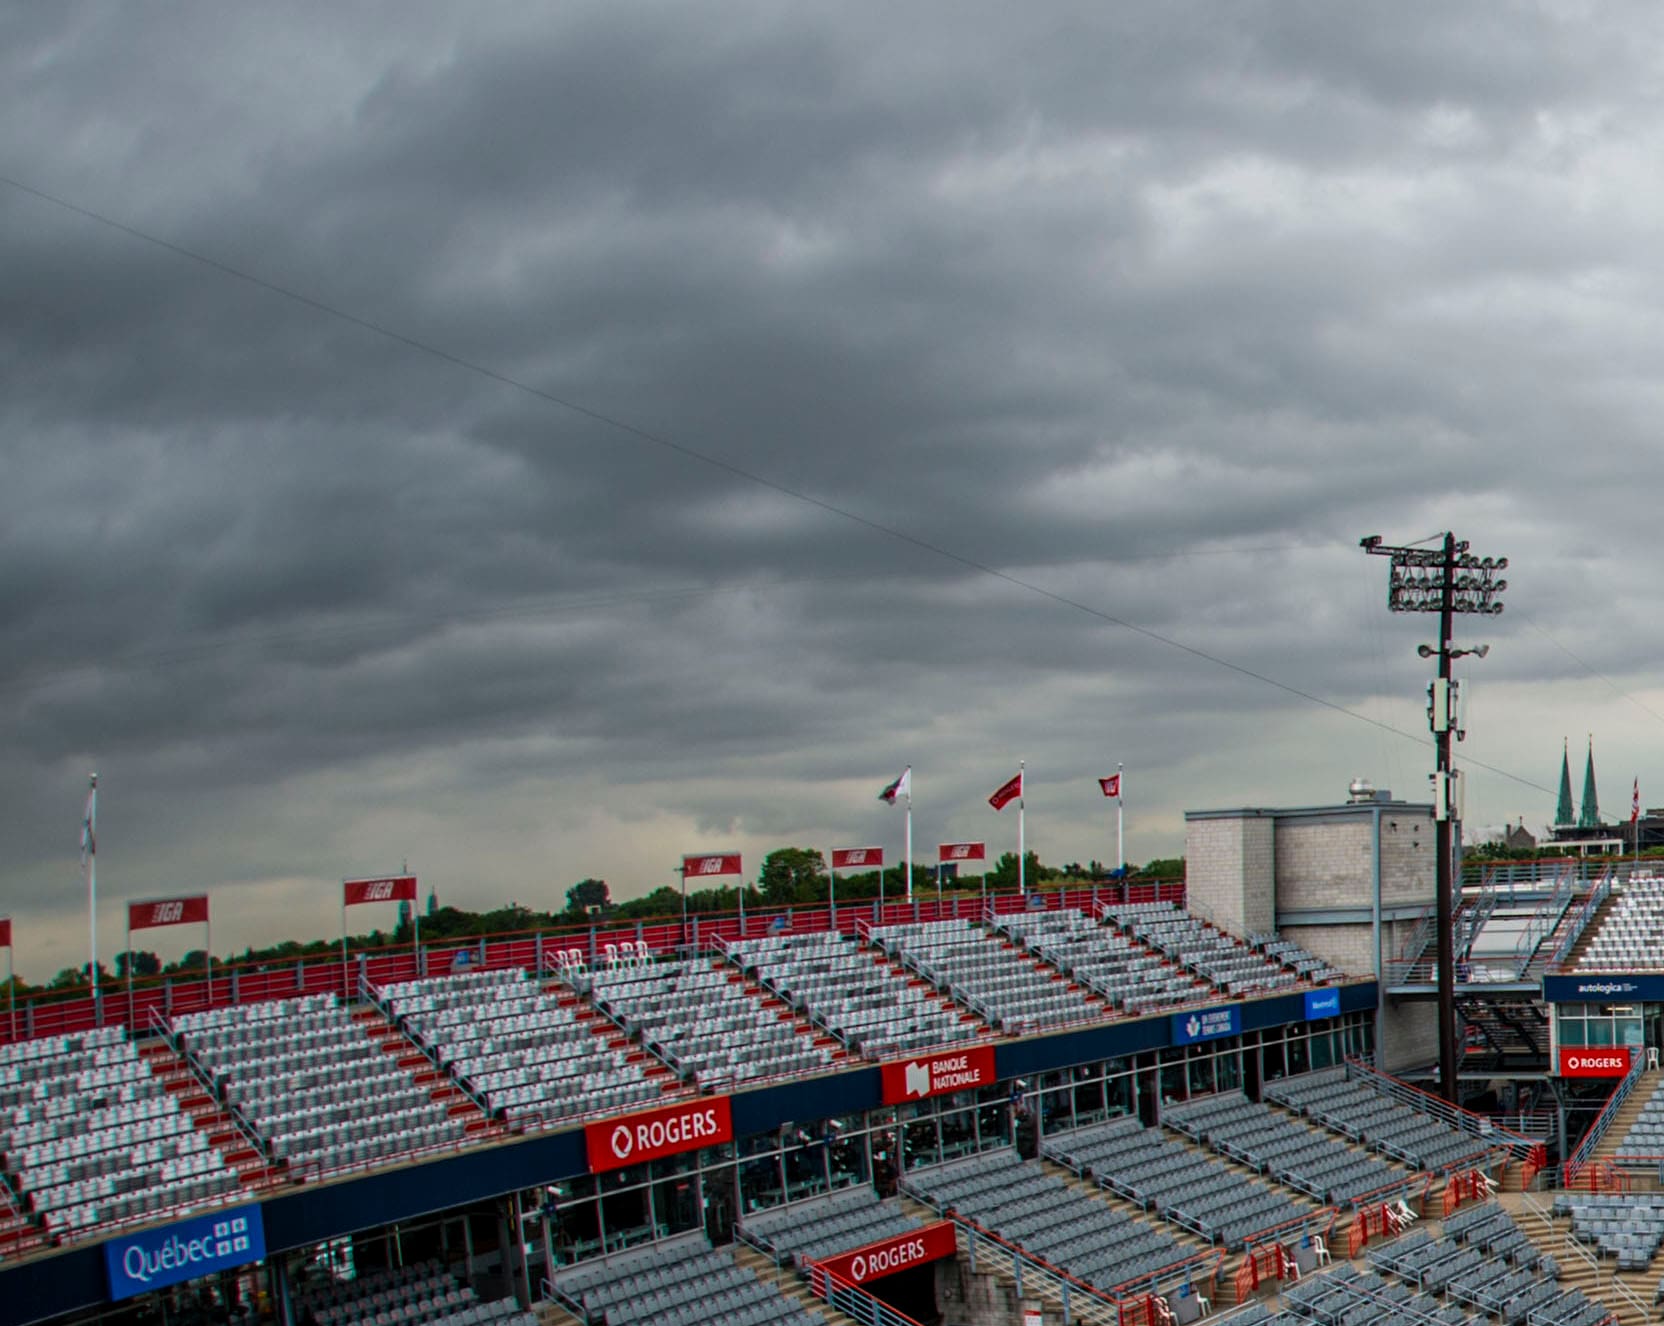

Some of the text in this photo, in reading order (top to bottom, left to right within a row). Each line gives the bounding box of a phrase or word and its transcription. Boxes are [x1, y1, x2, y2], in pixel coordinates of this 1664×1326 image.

[1579, 982, 1622, 994] autologica
[932, 1055, 968, 1074] BANQUE
[1581, 1058, 1623, 1068] ROGERS
[934, 1069, 980, 1090] NATIONALE
[637, 1110, 718, 1150] ROGERS
[123, 1235, 215, 1282] Québec
[869, 1239, 926, 1274] ROGERS
